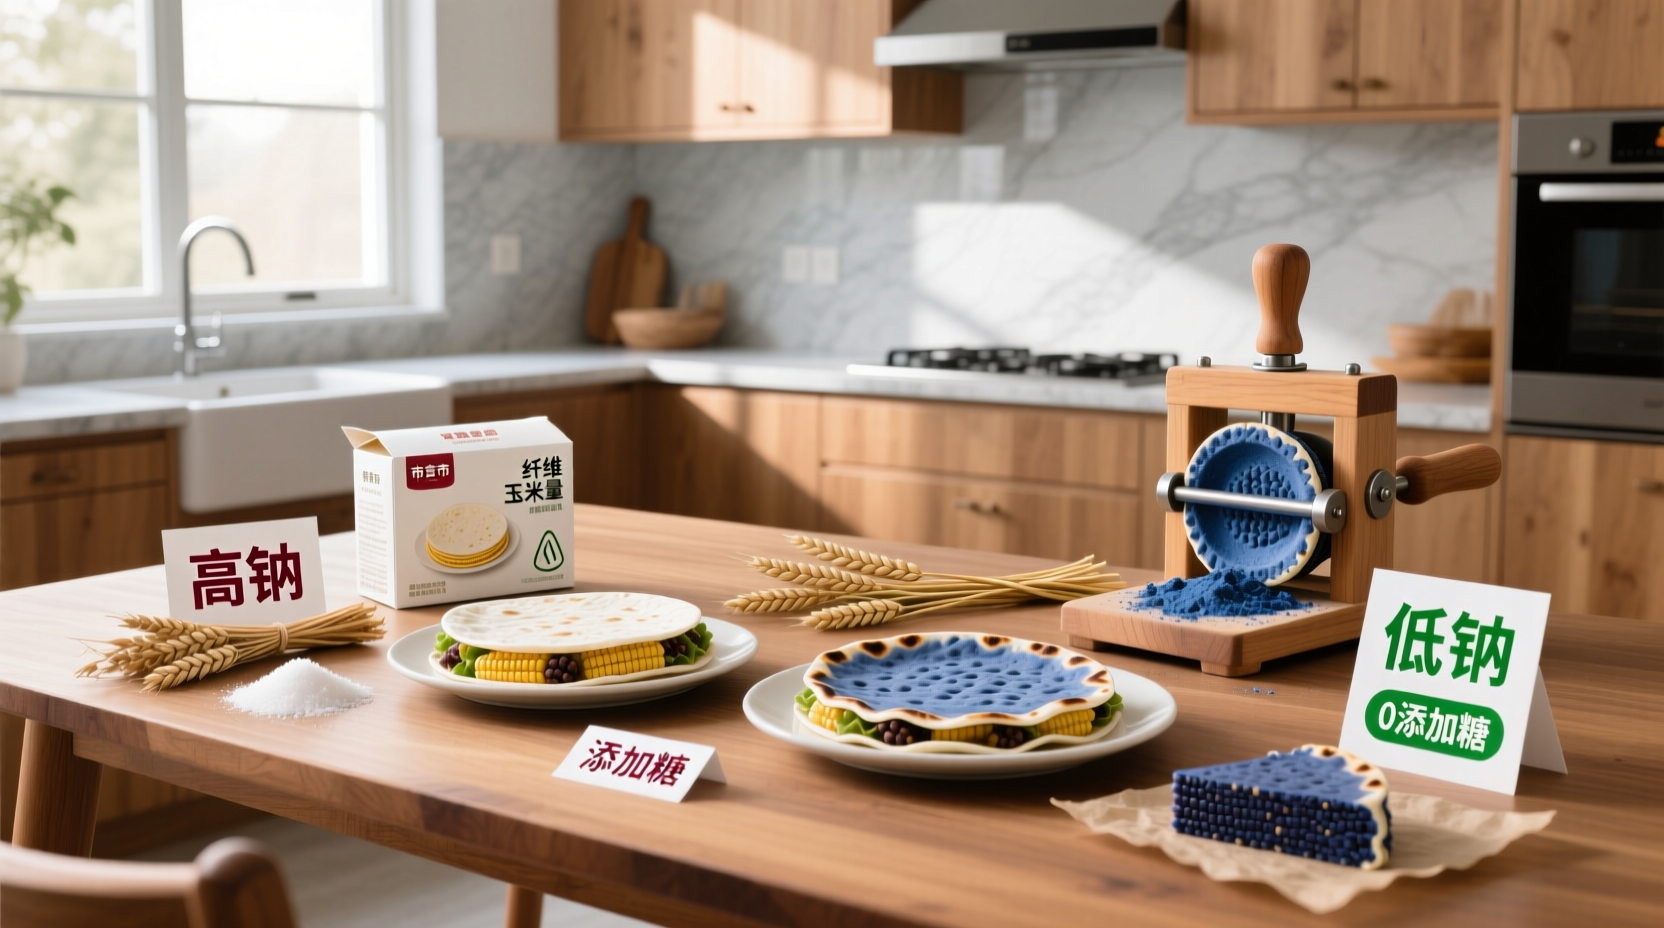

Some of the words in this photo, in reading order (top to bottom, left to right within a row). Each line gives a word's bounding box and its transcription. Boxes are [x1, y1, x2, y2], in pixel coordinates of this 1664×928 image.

[522, 455, 563, 479] 纤维
[189, 542, 303, 610] 高钠
[1385, 602, 1515, 687] 低钠
[1378, 701, 1491, 754] 0添加糖
[579, 739, 690, 786] 添加糖
